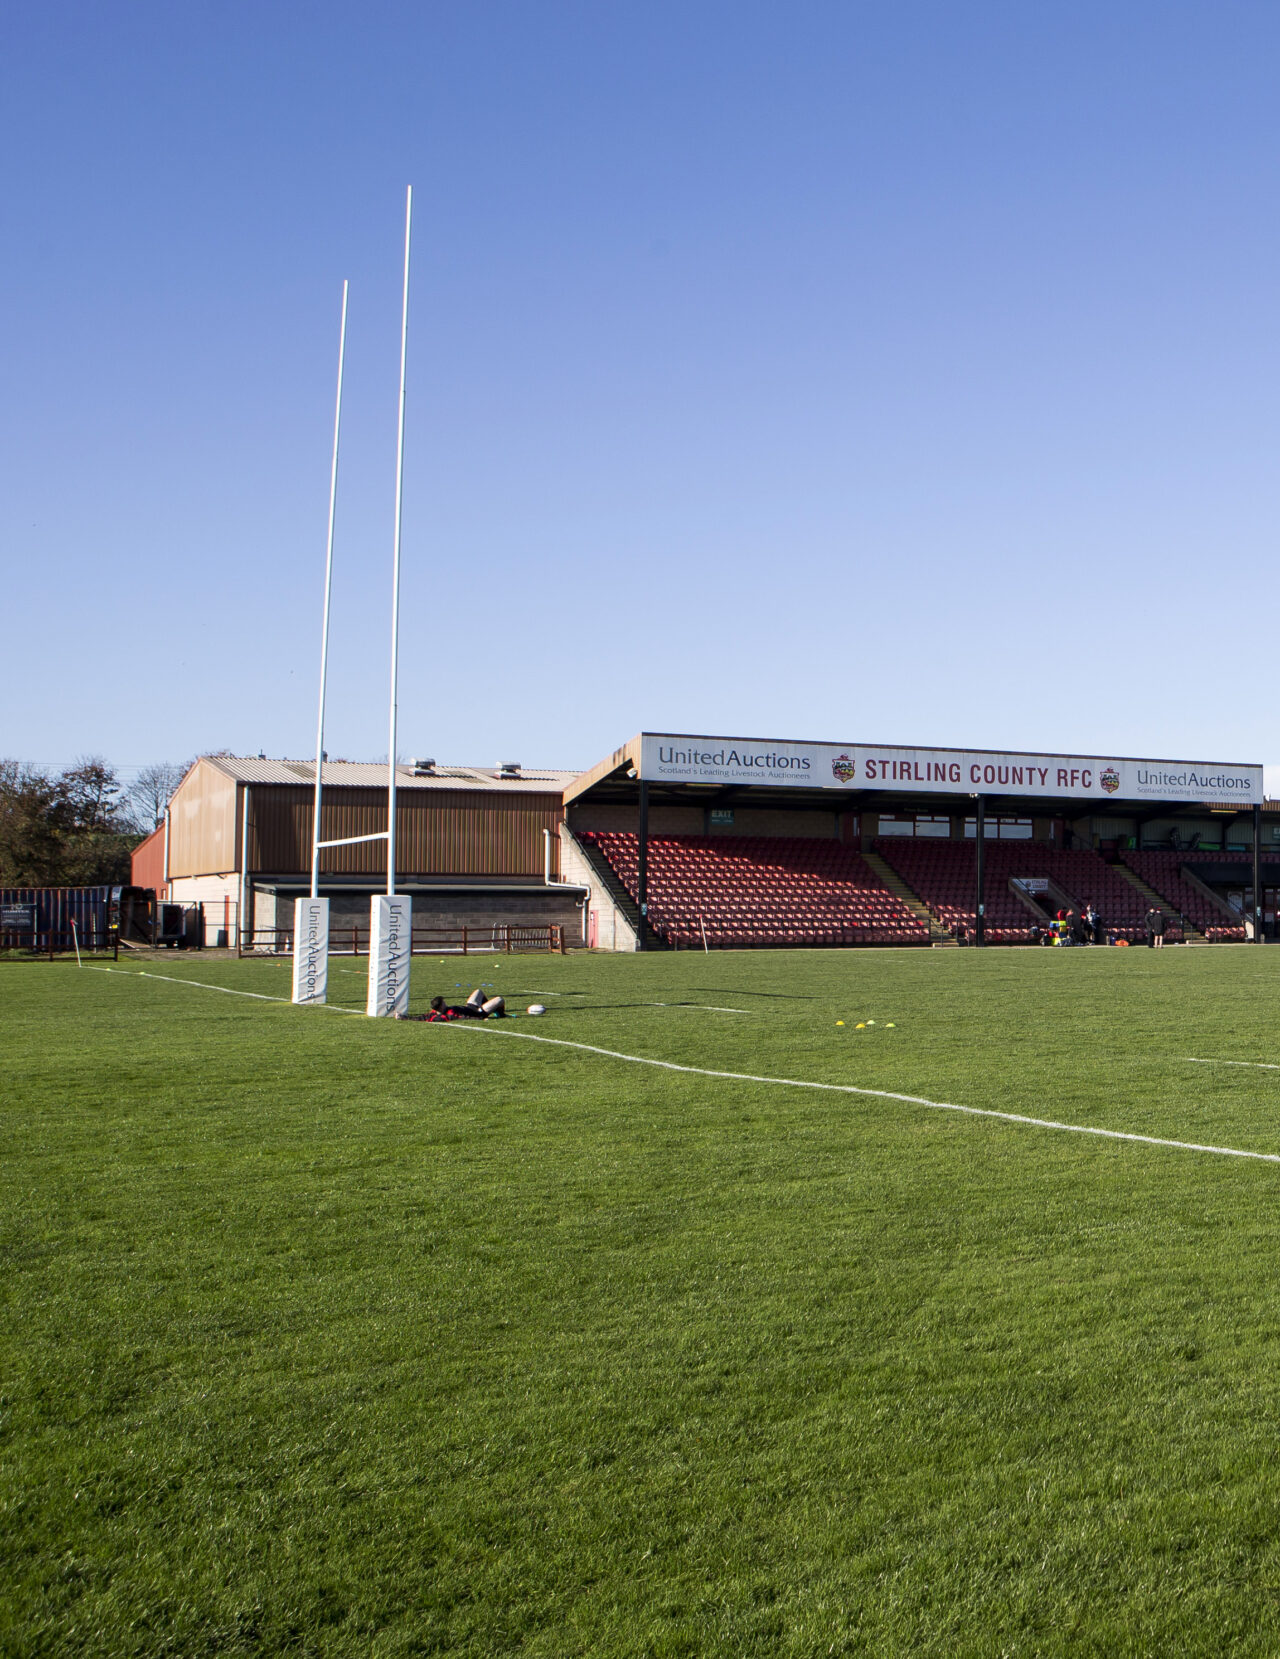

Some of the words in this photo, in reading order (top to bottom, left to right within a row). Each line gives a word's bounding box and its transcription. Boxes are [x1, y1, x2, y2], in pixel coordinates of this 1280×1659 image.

[658, 746, 811, 769] UnitedAuctions
[699, 767, 730, 778] Leading
[731, 769, 765, 778] Livestock
[768, 771, 811, 780] Auctioneers
[865, 759, 961, 783] STIRLING
[970, 764, 1049, 786] COUNTY
[1057, 768, 1092, 788] RFC
[1137, 770, 1251, 789] UnitedAuctions
[1168, 788, 1190, 797] Leading
[711, 810, 732, 819] EXIT
[307, 905, 321, 999] UnitedAuctions
[386, 904, 402, 1012] UnitedAuctions
